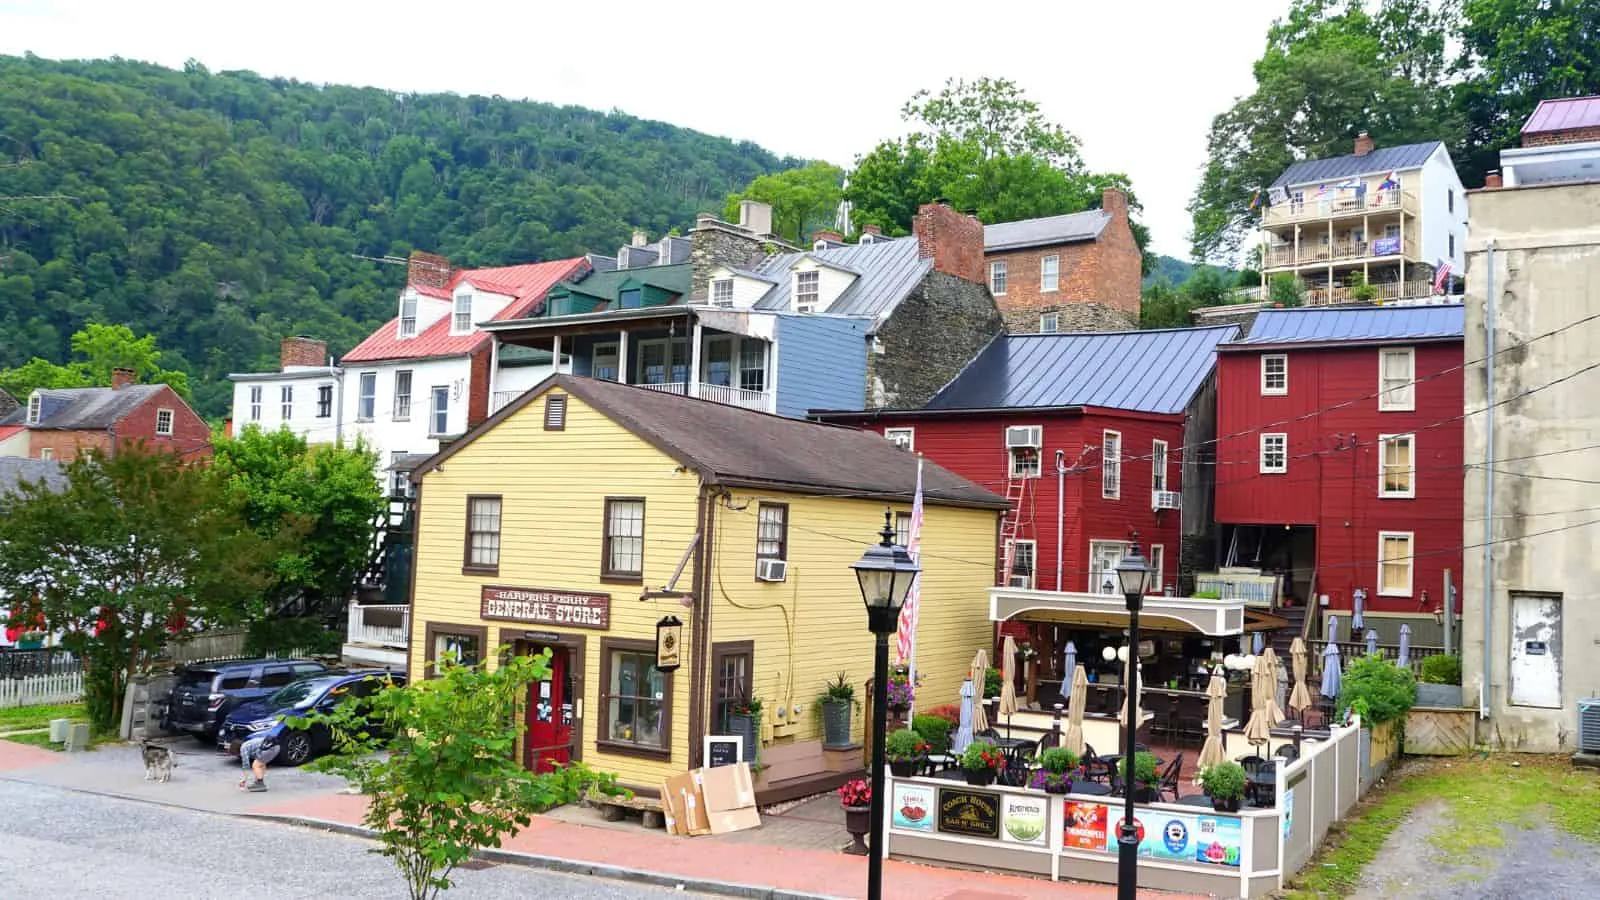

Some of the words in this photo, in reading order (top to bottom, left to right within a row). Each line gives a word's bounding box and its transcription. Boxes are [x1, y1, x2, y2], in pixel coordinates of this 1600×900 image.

[499, 591, 549, 601] HARPERS
[552, 595, 590, 605] FERRY
[488, 599, 553, 619] GENERAL
[556, 605, 601, 625] STORE
[943, 795, 967, 811] COACH
